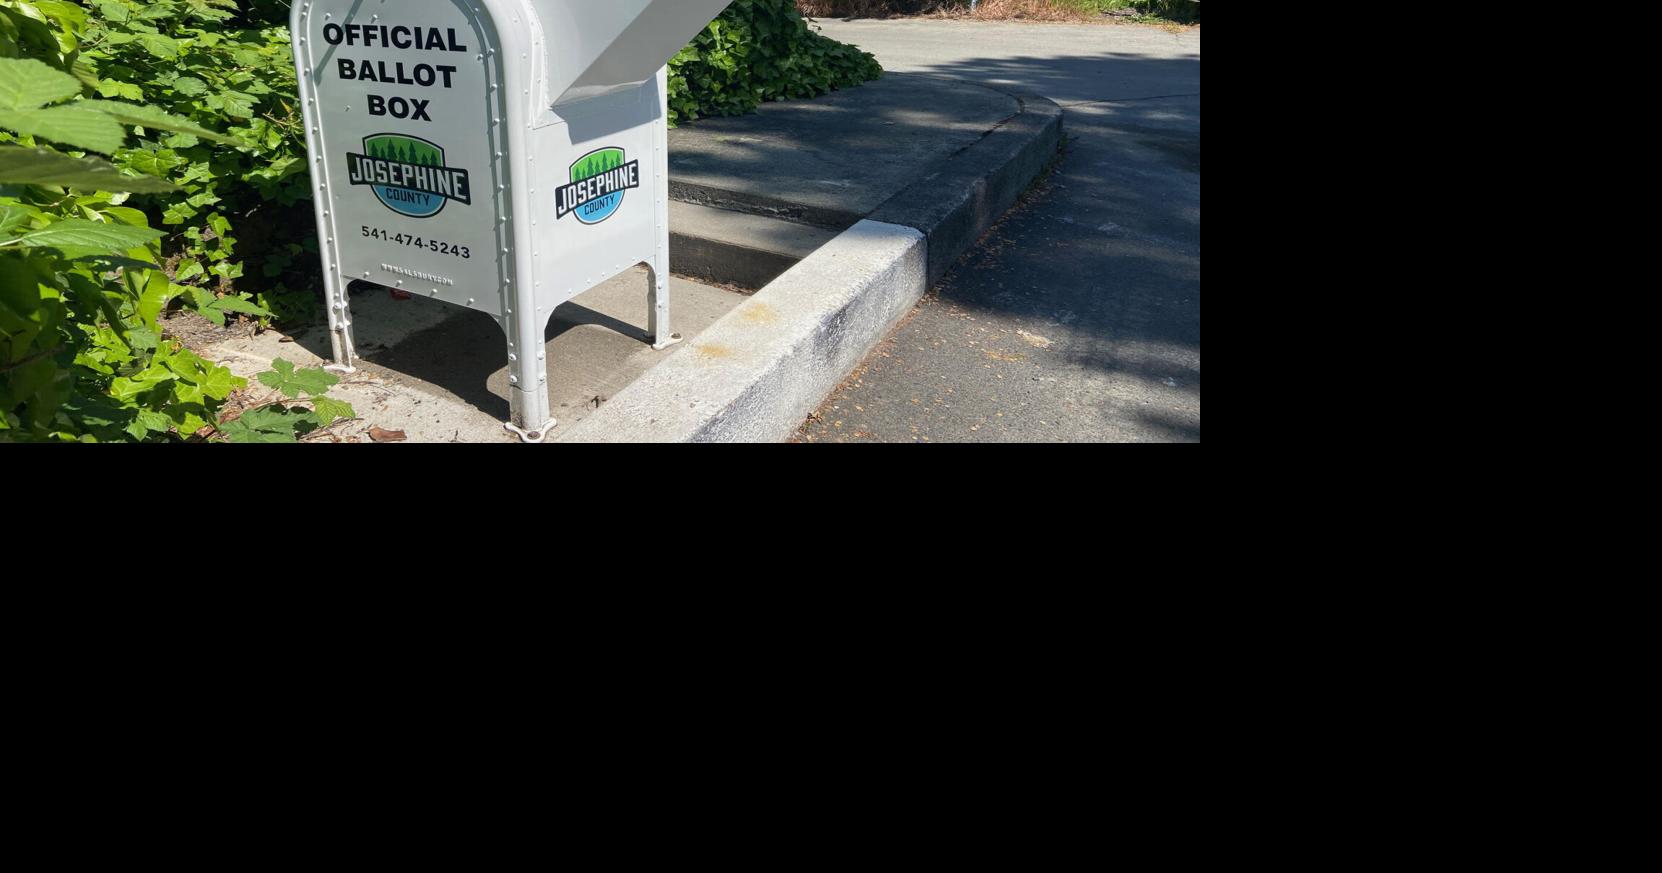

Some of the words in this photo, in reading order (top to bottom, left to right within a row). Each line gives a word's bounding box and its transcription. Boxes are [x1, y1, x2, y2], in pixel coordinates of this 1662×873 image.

[323, 23, 466, 51] OFFICIAL
[338, 58, 457, 88] BALLOT
[367, 94, 432, 122] BOX
[352, 157, 467, 200] JOSEPHINE
[558, 163, 637, 215] JOSEPHINE
[386, 188, 430, 206] COUNTY
[584, 194, 615, 215] COUNTY
[362, 225, 471, 258] 541-474-5243
